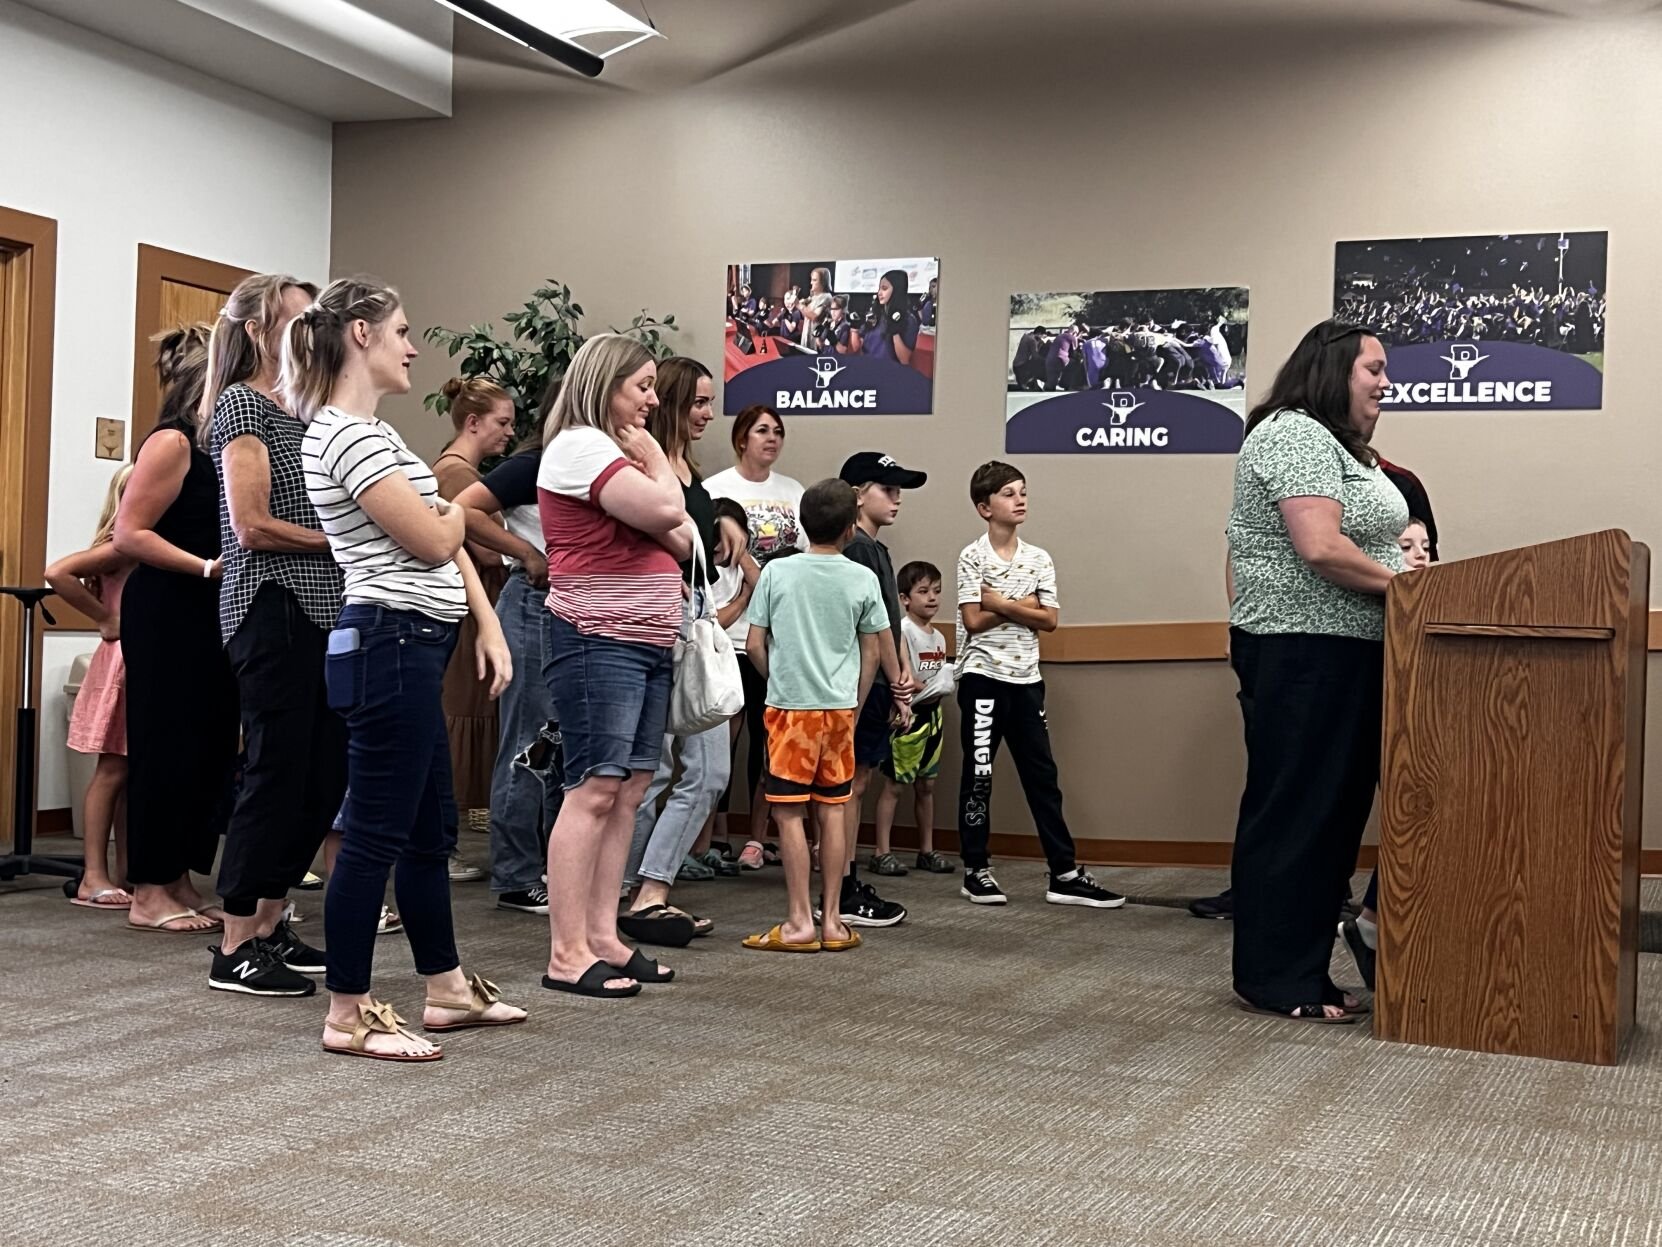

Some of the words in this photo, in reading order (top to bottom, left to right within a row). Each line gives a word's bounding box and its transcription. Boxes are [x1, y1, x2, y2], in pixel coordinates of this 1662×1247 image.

[776, 389, 877, 409] BALANCE
[1377, 381, 1552, 403] EXCELLENCE
[1076, 427, 1168, 447] CARING
[918, 660, 943, 671] RAC
